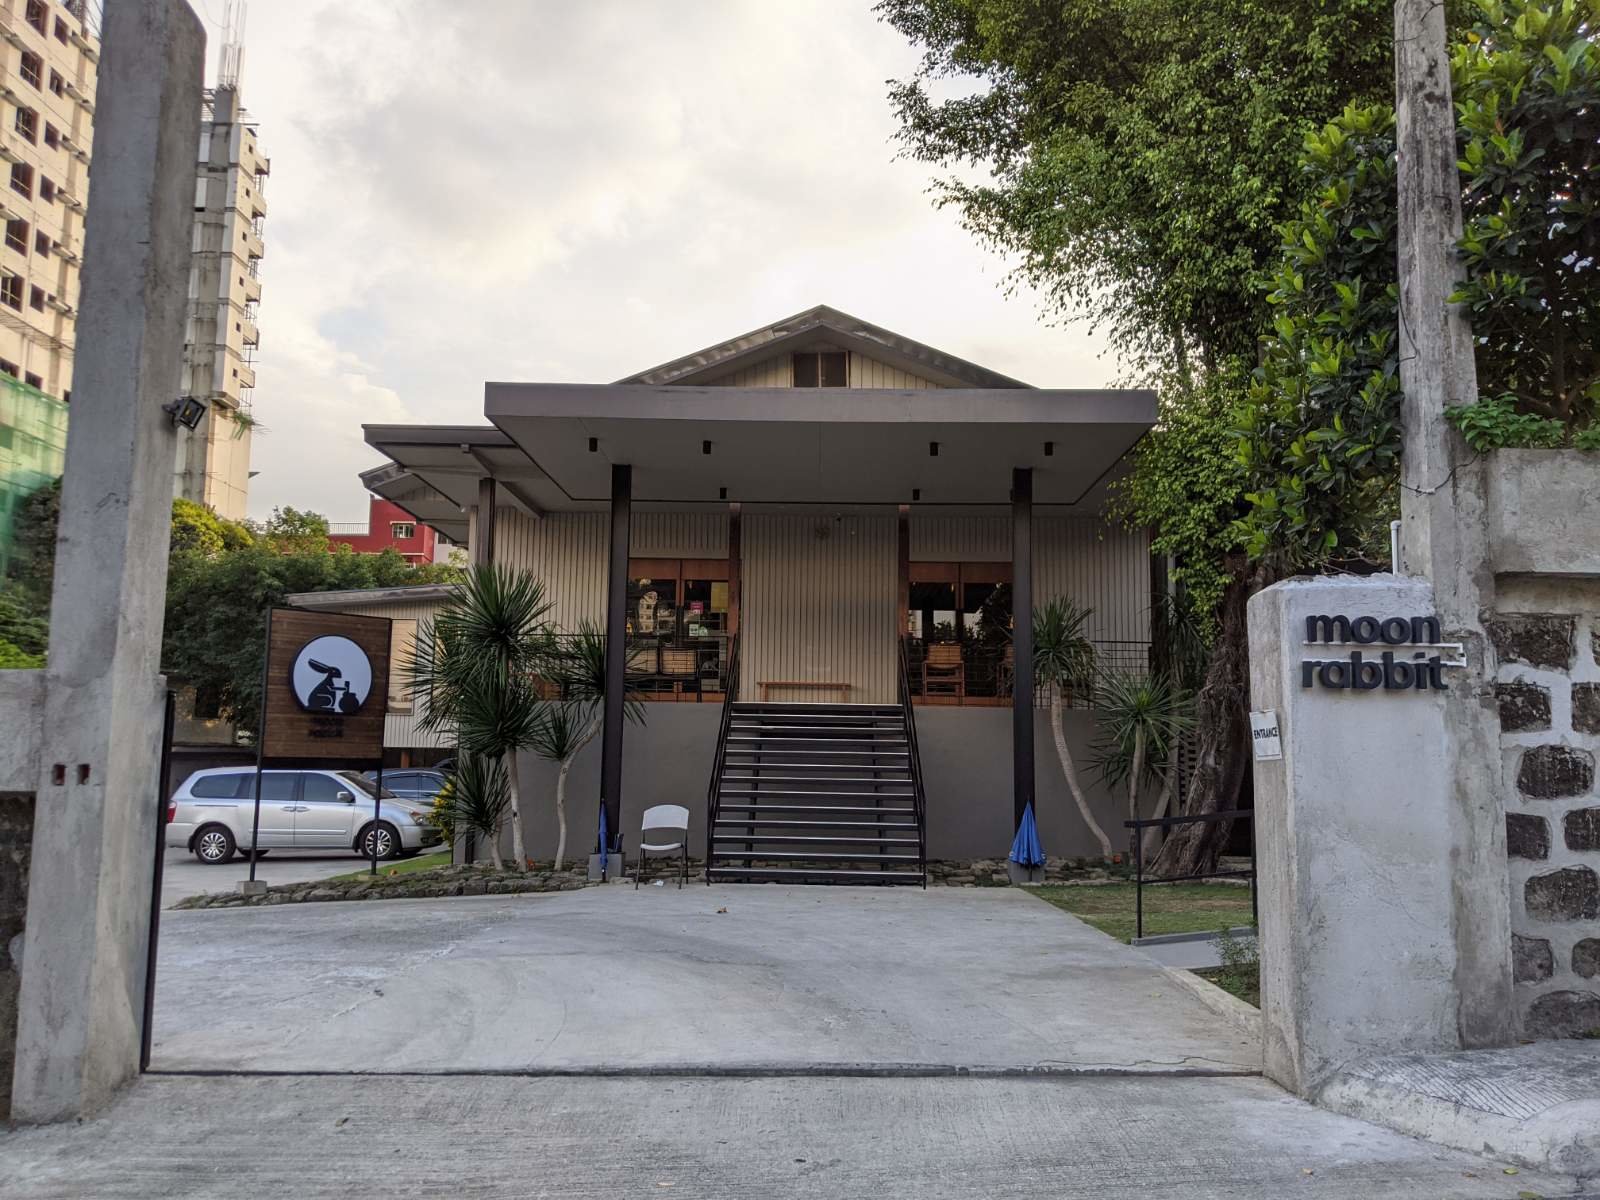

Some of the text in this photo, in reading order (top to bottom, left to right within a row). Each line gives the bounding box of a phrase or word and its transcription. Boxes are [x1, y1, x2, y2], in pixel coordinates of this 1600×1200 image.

[1306, 614, 1440, 644] moon
[1302, 651, 1448, 689] rabbit
[1253, 726, 1278, 740] ENTRANCE
